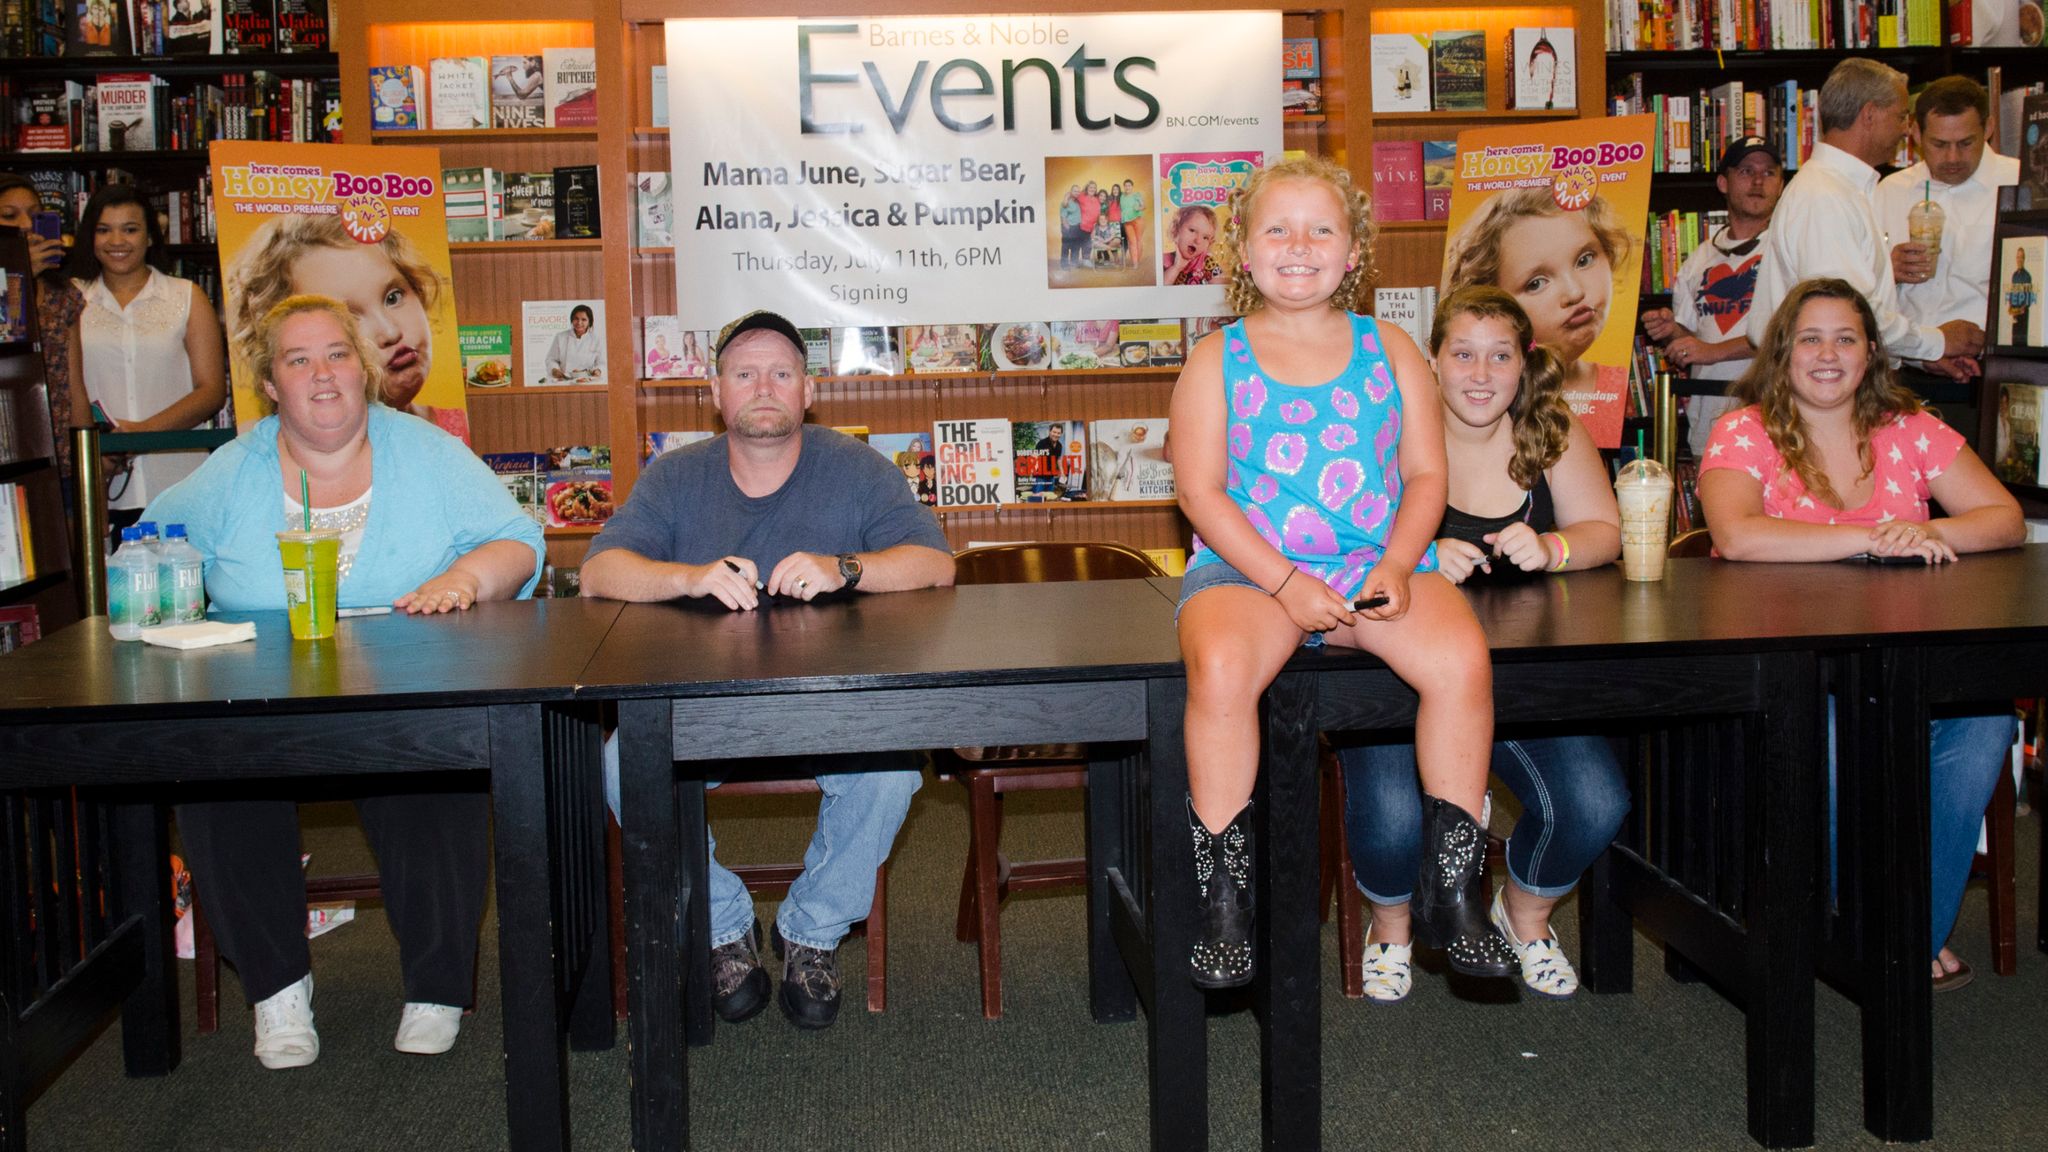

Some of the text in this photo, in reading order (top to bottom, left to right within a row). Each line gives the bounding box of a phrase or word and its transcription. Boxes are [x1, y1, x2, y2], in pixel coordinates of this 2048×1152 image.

[869, 22, 1069, 47] Barnes & Noble
[798, 24, 1160, 134] Events
[101, 89, 146, 104] MURDER
[493, 105, 537, 119] NINE
[1166, 115, 1259, 127] BN.COM/events
[1486, 144, 1544, 157] here comes
[250, 162, 321, 176] here comes
[704, 158, 1026, 190] Mama June, Sugar Bear,
[1462, 152, 1551, 178] Honey
[222, 166, 333, 203] Honey
[1467, 172, 1627, 191] THE WORLD PREMIERE EVENT
[1562, 166, 1595, 187] WATCH
[1555, 181, 1591, 208] SNIFF
[234, 203, 420, 216] THE WORLD PREMIERE EVENT
[349, 195, 388, 219] WATCH
[696, 205, 781, 232] Alana,
[887, 202, 908, 226] &
[915, 199, 1035, 231] Pumpkin
[343, 211, 385, 241] SNIFF
[732, 247, 1001, 274] Thursday, July 11th, 6PM
[830, 283, 908, 304] Signing
[1379, 292, 1415, 300] STEAL
[528, 315, 567, 324] FLAVORS
[1381, 310, 1415, 319] MENU
[458, 335, 503, 345] RIRACHA
[1563, 390, 1620, 403] ednesdays
[938, 421, 978, 443] THE
[940, 463, 976, 485] ING
[1015, 454, 1083, 477] GRILL IT!
[941, 483, 1001, 506] BOOK
[1140, 485, 1175, 494] KITCHEN
[134, 571, 157, 592] FIJI
[179, 567, 201, 588] FIJI
